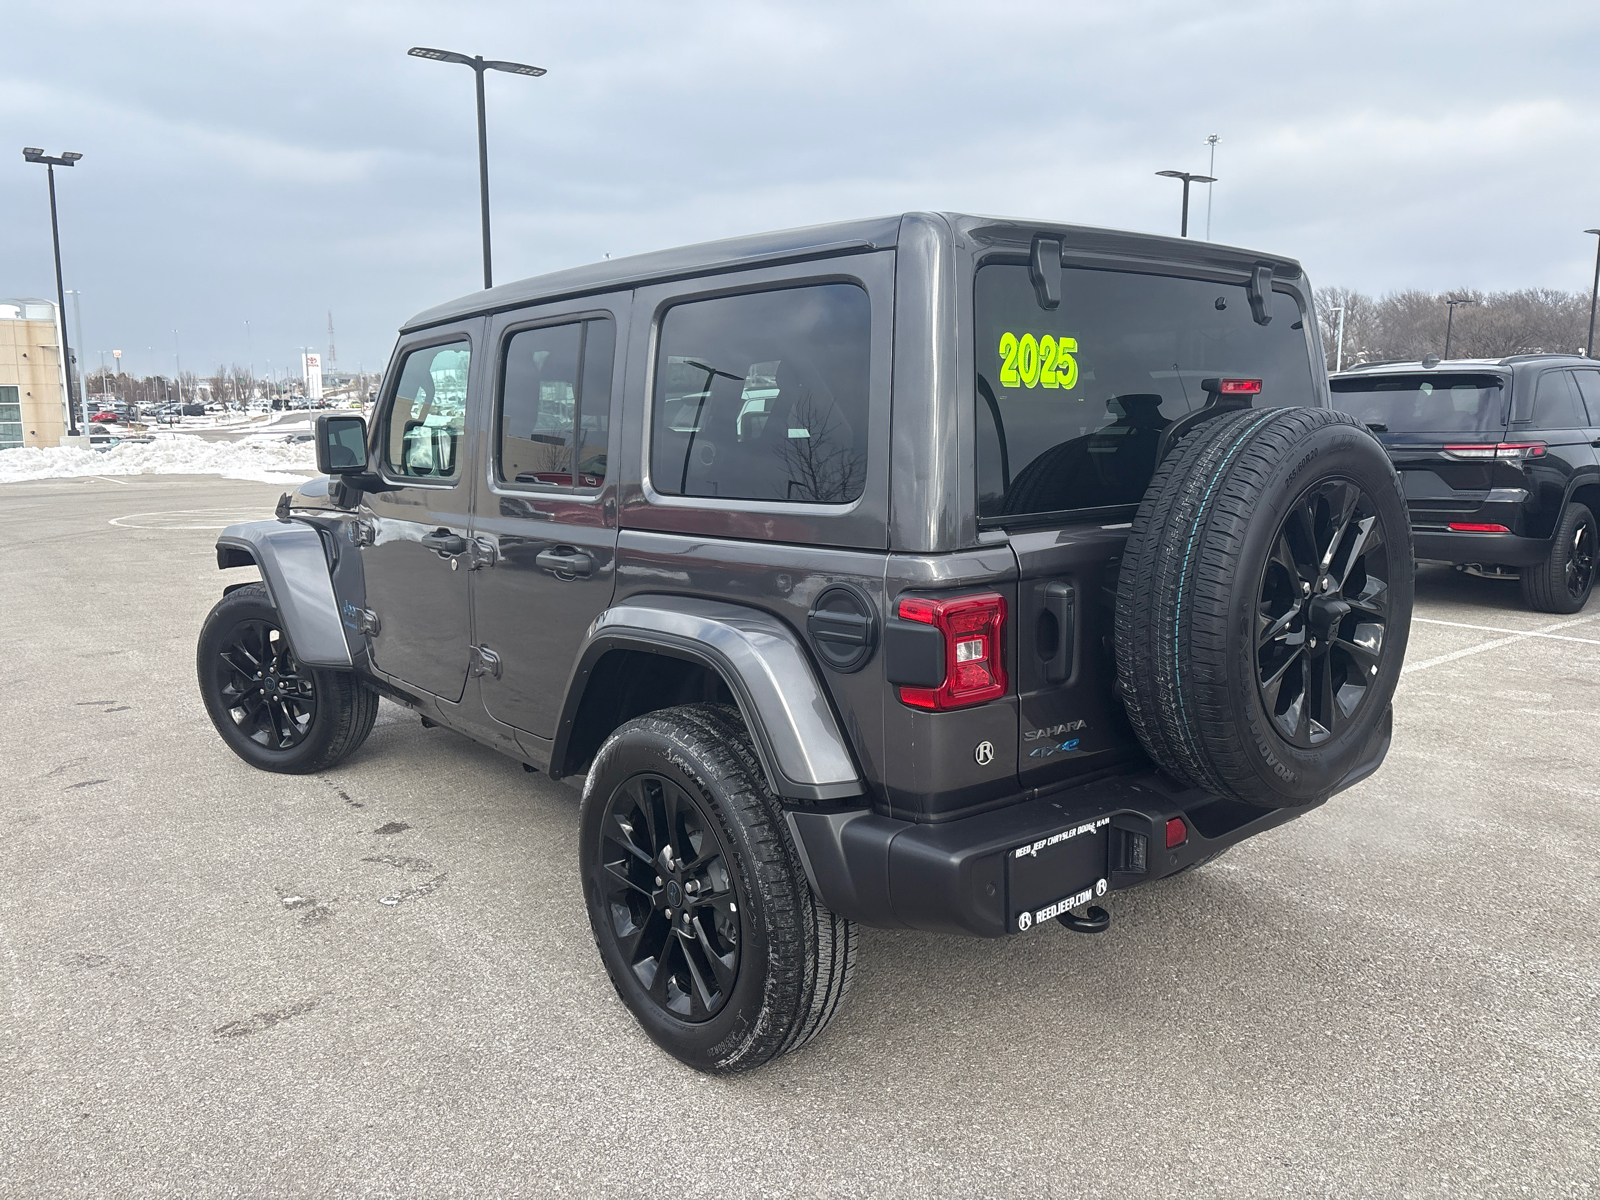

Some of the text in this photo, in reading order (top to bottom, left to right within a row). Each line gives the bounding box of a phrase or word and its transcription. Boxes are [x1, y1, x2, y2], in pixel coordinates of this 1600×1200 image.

[999, 332, 1078, 390] 2025
[1024, 720, 1087, 741] SAHARA
[1015, 817, 1110, 858] REED JEEP CHRYSLER DODGE RAM
[1036, 888, 1093, 924] REEDJEEP.COM
